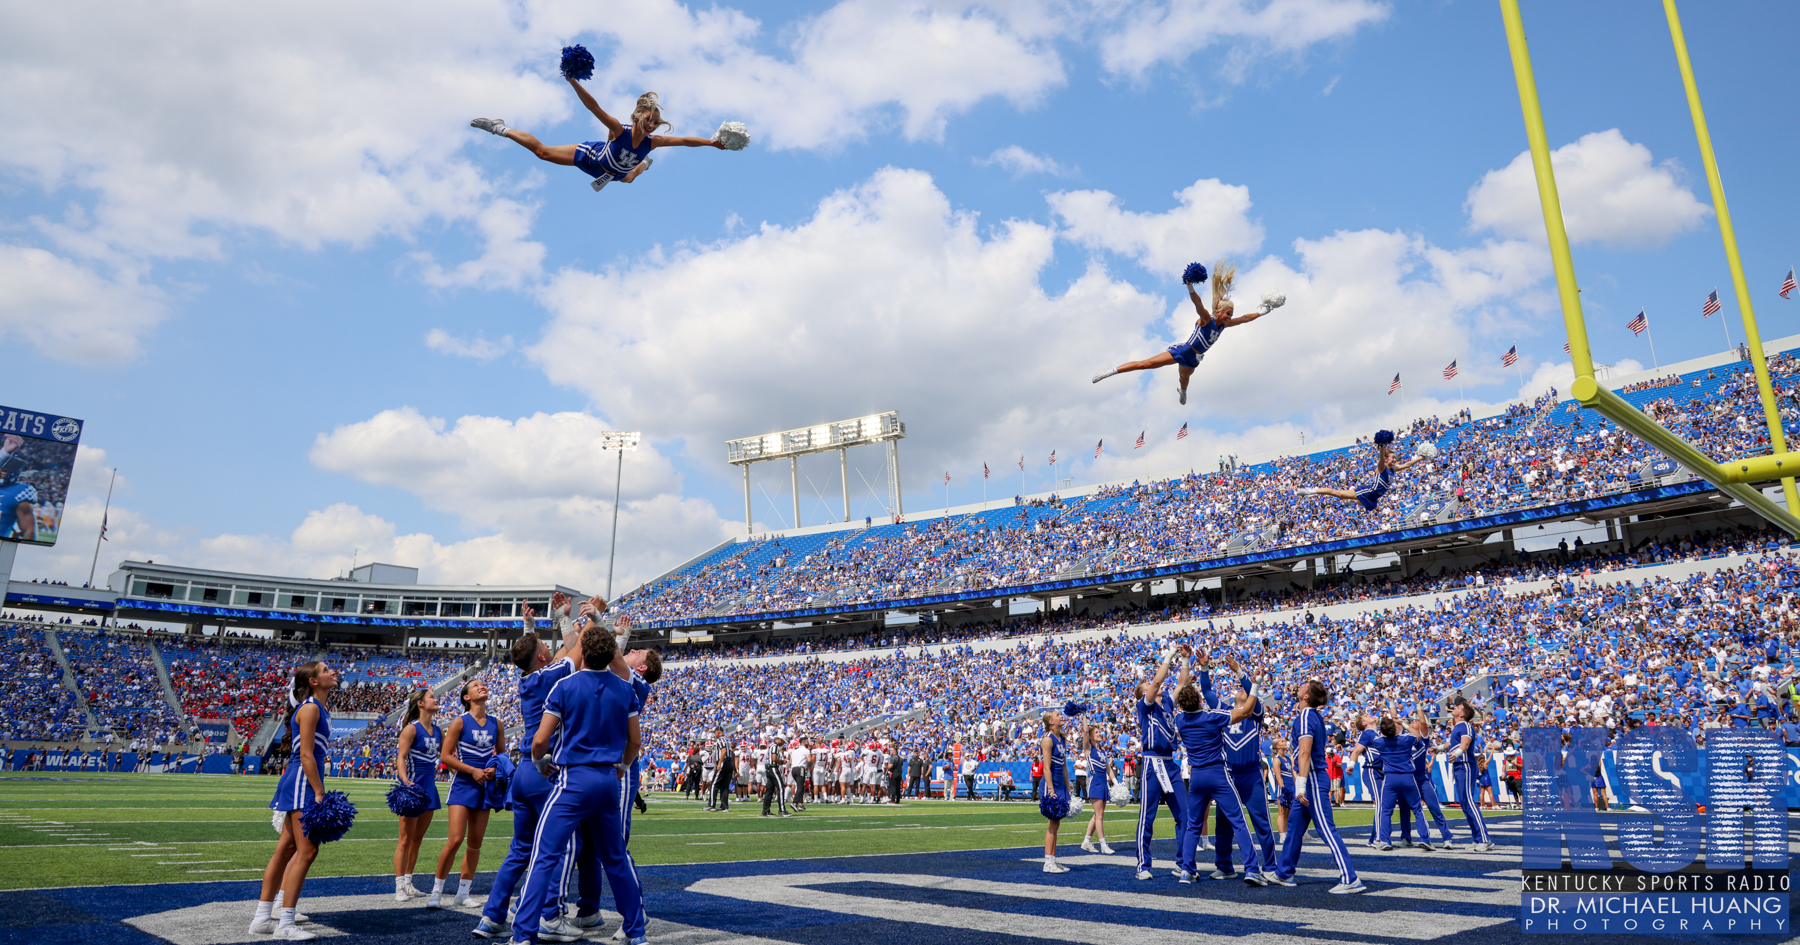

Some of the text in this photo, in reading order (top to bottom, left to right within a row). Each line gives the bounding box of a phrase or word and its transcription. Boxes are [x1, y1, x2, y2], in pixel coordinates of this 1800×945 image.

[595, 174, 611, 186] BLUE
[0, 409, 46, 435] ATS
[1657, 462, 1670, 471] 204
[472, 729, 494, 747] UK
[424, 737, 440, 755] UK
[760, 753, 765, 762] 7
[957, 772, 998, 785] TOTA
